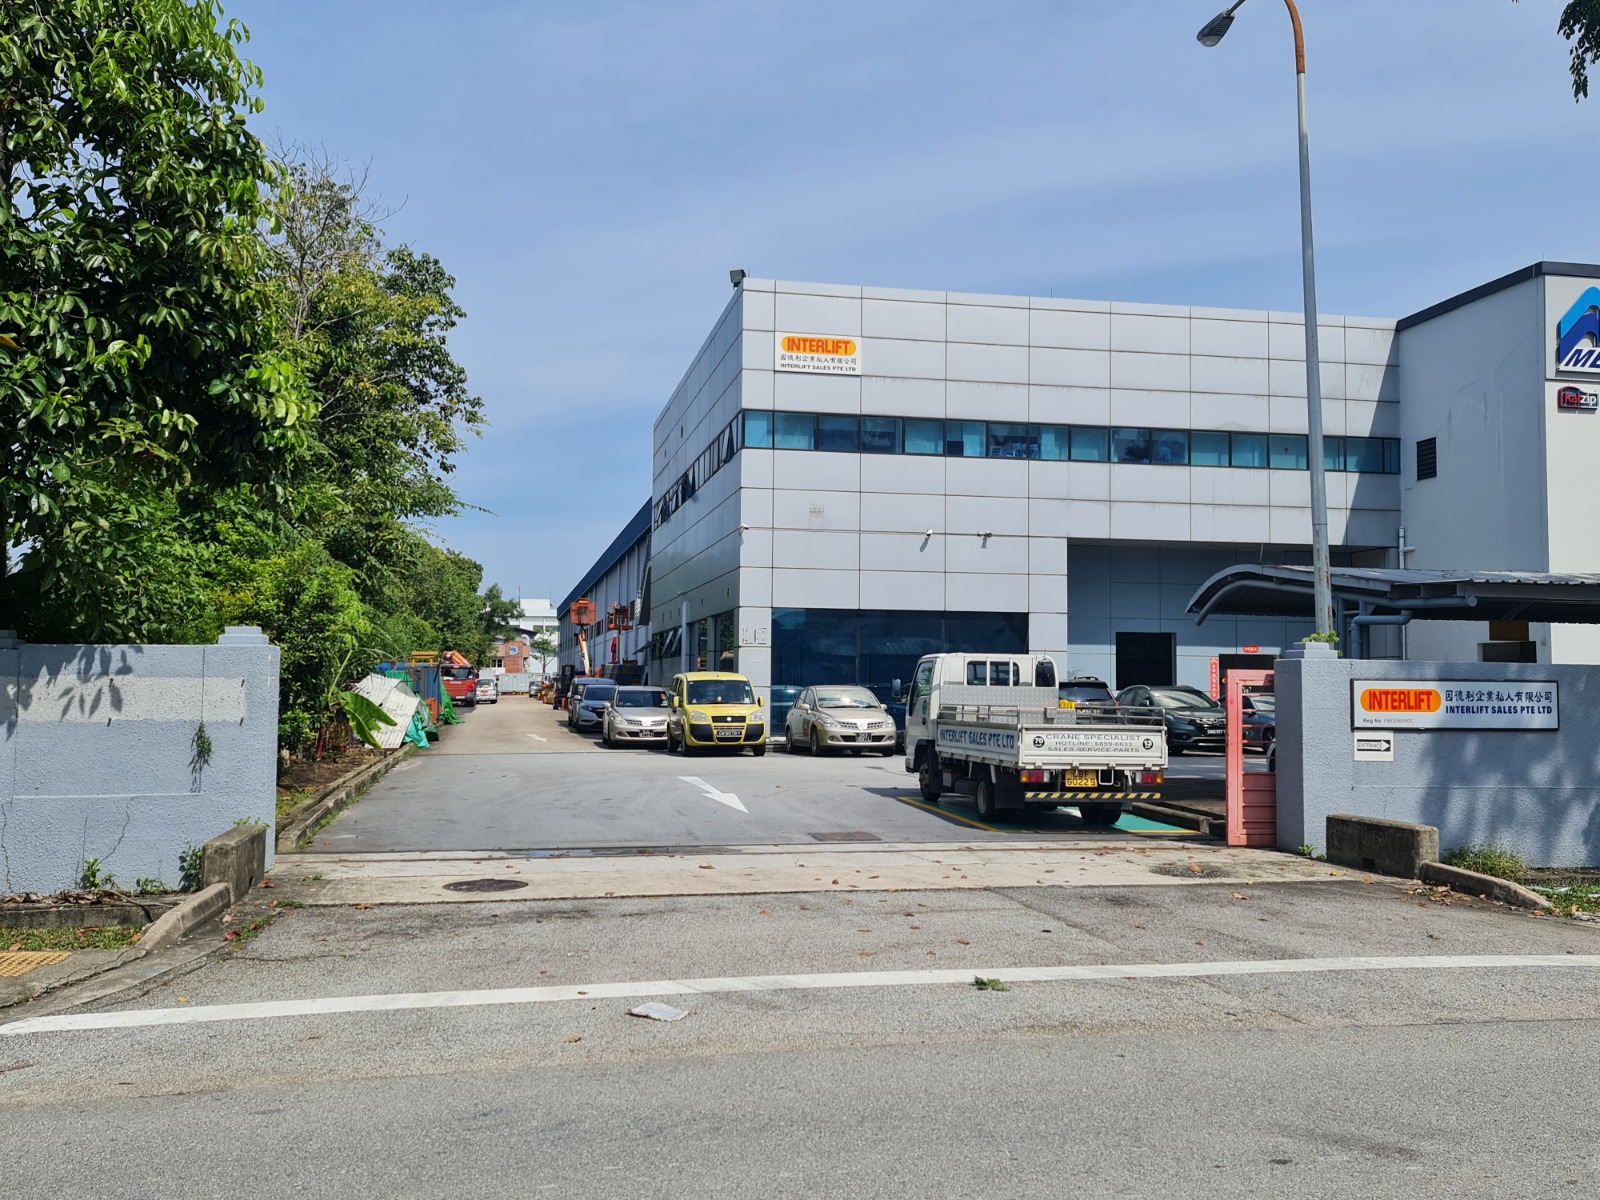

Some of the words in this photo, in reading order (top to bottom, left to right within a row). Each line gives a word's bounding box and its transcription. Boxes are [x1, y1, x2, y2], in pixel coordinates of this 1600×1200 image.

[787, 337, 851, 354] INTERLIFT
[1565, 393, 1597, 406] Kalzip
[1368, 690, 1433, 710] INTERLIFT
[1445, 705, 1490, 714] INTERLIFT
[1491, 705, 1518, 714] SALES
[1520, 706, 1535, 714] PTE
[1537, 706, 1552, 714] LTD
[939, 728, 968, 744] INTERLIFT
[968, 731, 987, 747] SALES
[988, 733, 1001, 748] PTE
[1001, 734, 1014, 749] LTD
[1045, 733, 1081, 741] CRANE
